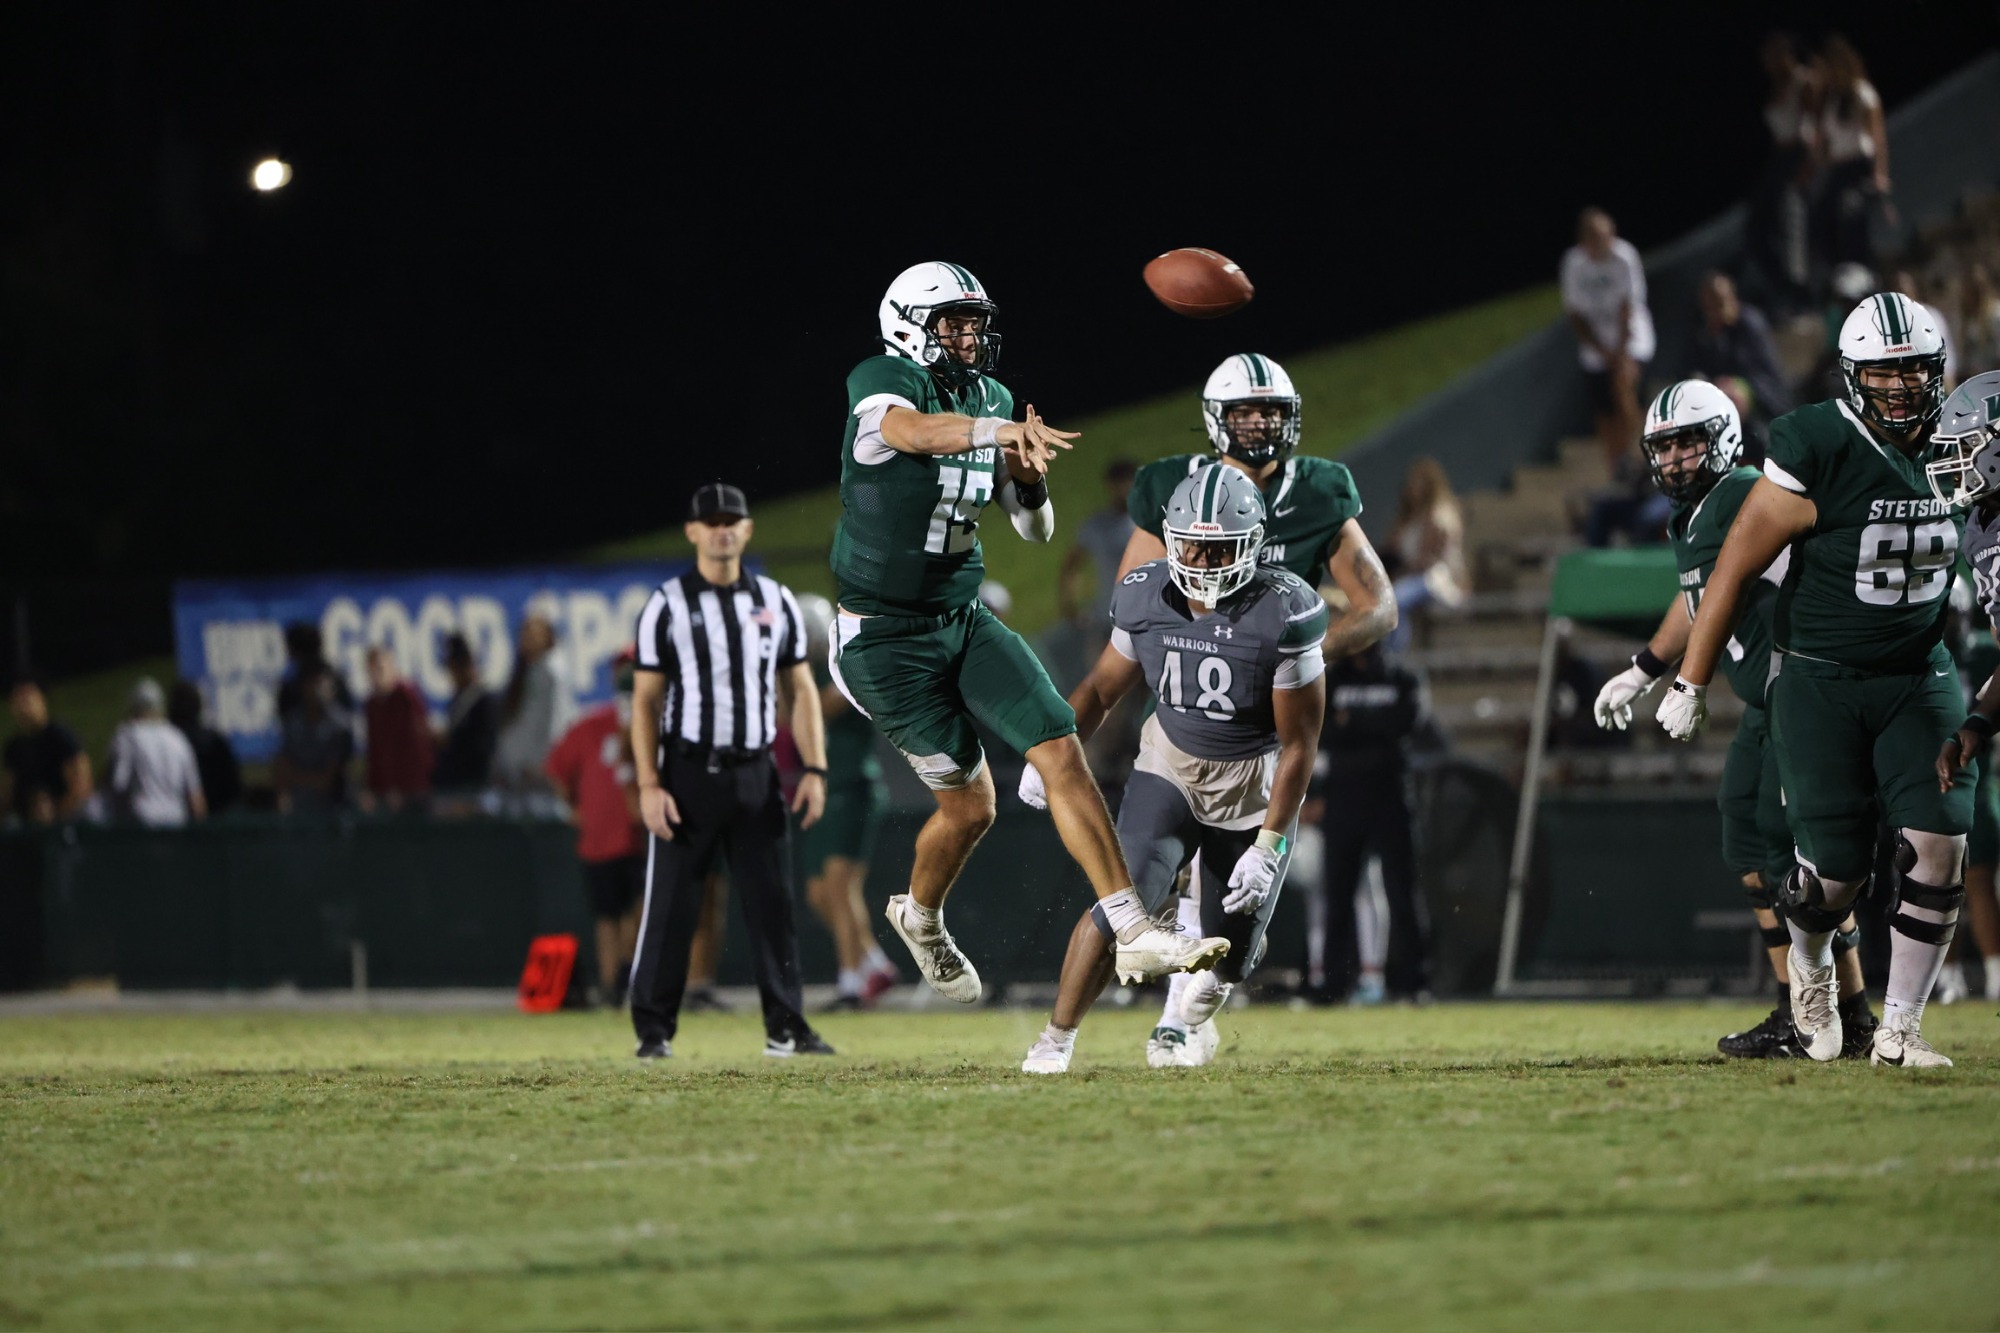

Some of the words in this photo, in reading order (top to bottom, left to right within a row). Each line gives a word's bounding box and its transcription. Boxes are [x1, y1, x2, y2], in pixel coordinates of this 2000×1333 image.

[924, 465, 994, 554] 15
[1868, 499, 1952, 521] STETSON
[1855, 518, 1959, 606] 69
[1163, 634, 1219, 654] WARRIORS
[1158, 651, 1237, 721] 48
